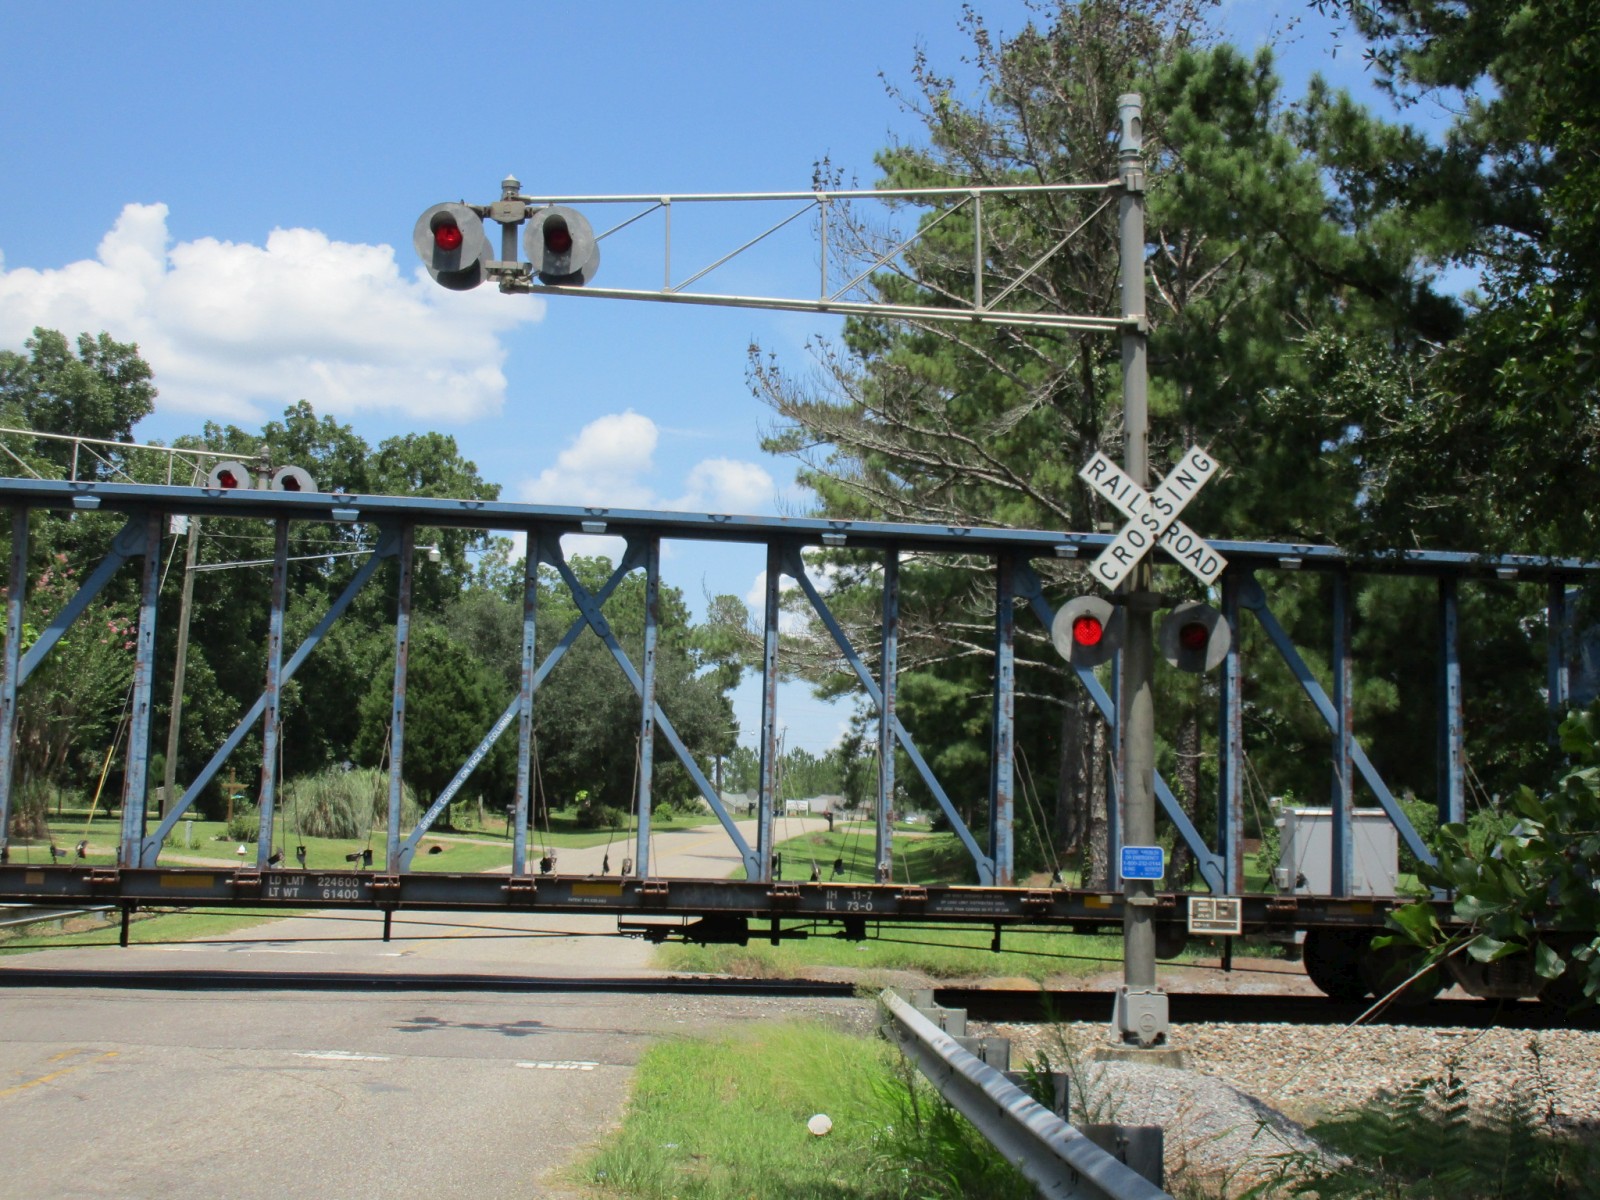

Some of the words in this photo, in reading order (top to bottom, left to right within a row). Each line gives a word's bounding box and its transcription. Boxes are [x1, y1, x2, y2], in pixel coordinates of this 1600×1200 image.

[1087, 459, 1141, 514] RAIL
[1099, 454, 1210, 581] CROSSING
[1160, 522, 1218, 576] ROAD
[420, 805, 442, 830] SPECIAL
[440, 779, 462, 804] COATING
[460, 768, 470, 778] ON
[468, 752, 482, 768] FACE
[481, 741, 489, 752] OF
[489, 712, 513, 742] COLUMNS
[268, 887, 280, 897] LT
[283, 887, 300, 898] WT
[322, 889, 359, 900] 61400
[269, 875, 282, 885] LD
[826, 890, 838, 900] IH
[851, 890, 873, 900] 11-7
[826, 901, 836, 911] IL
[846, 901, 873, 912] 73-0
